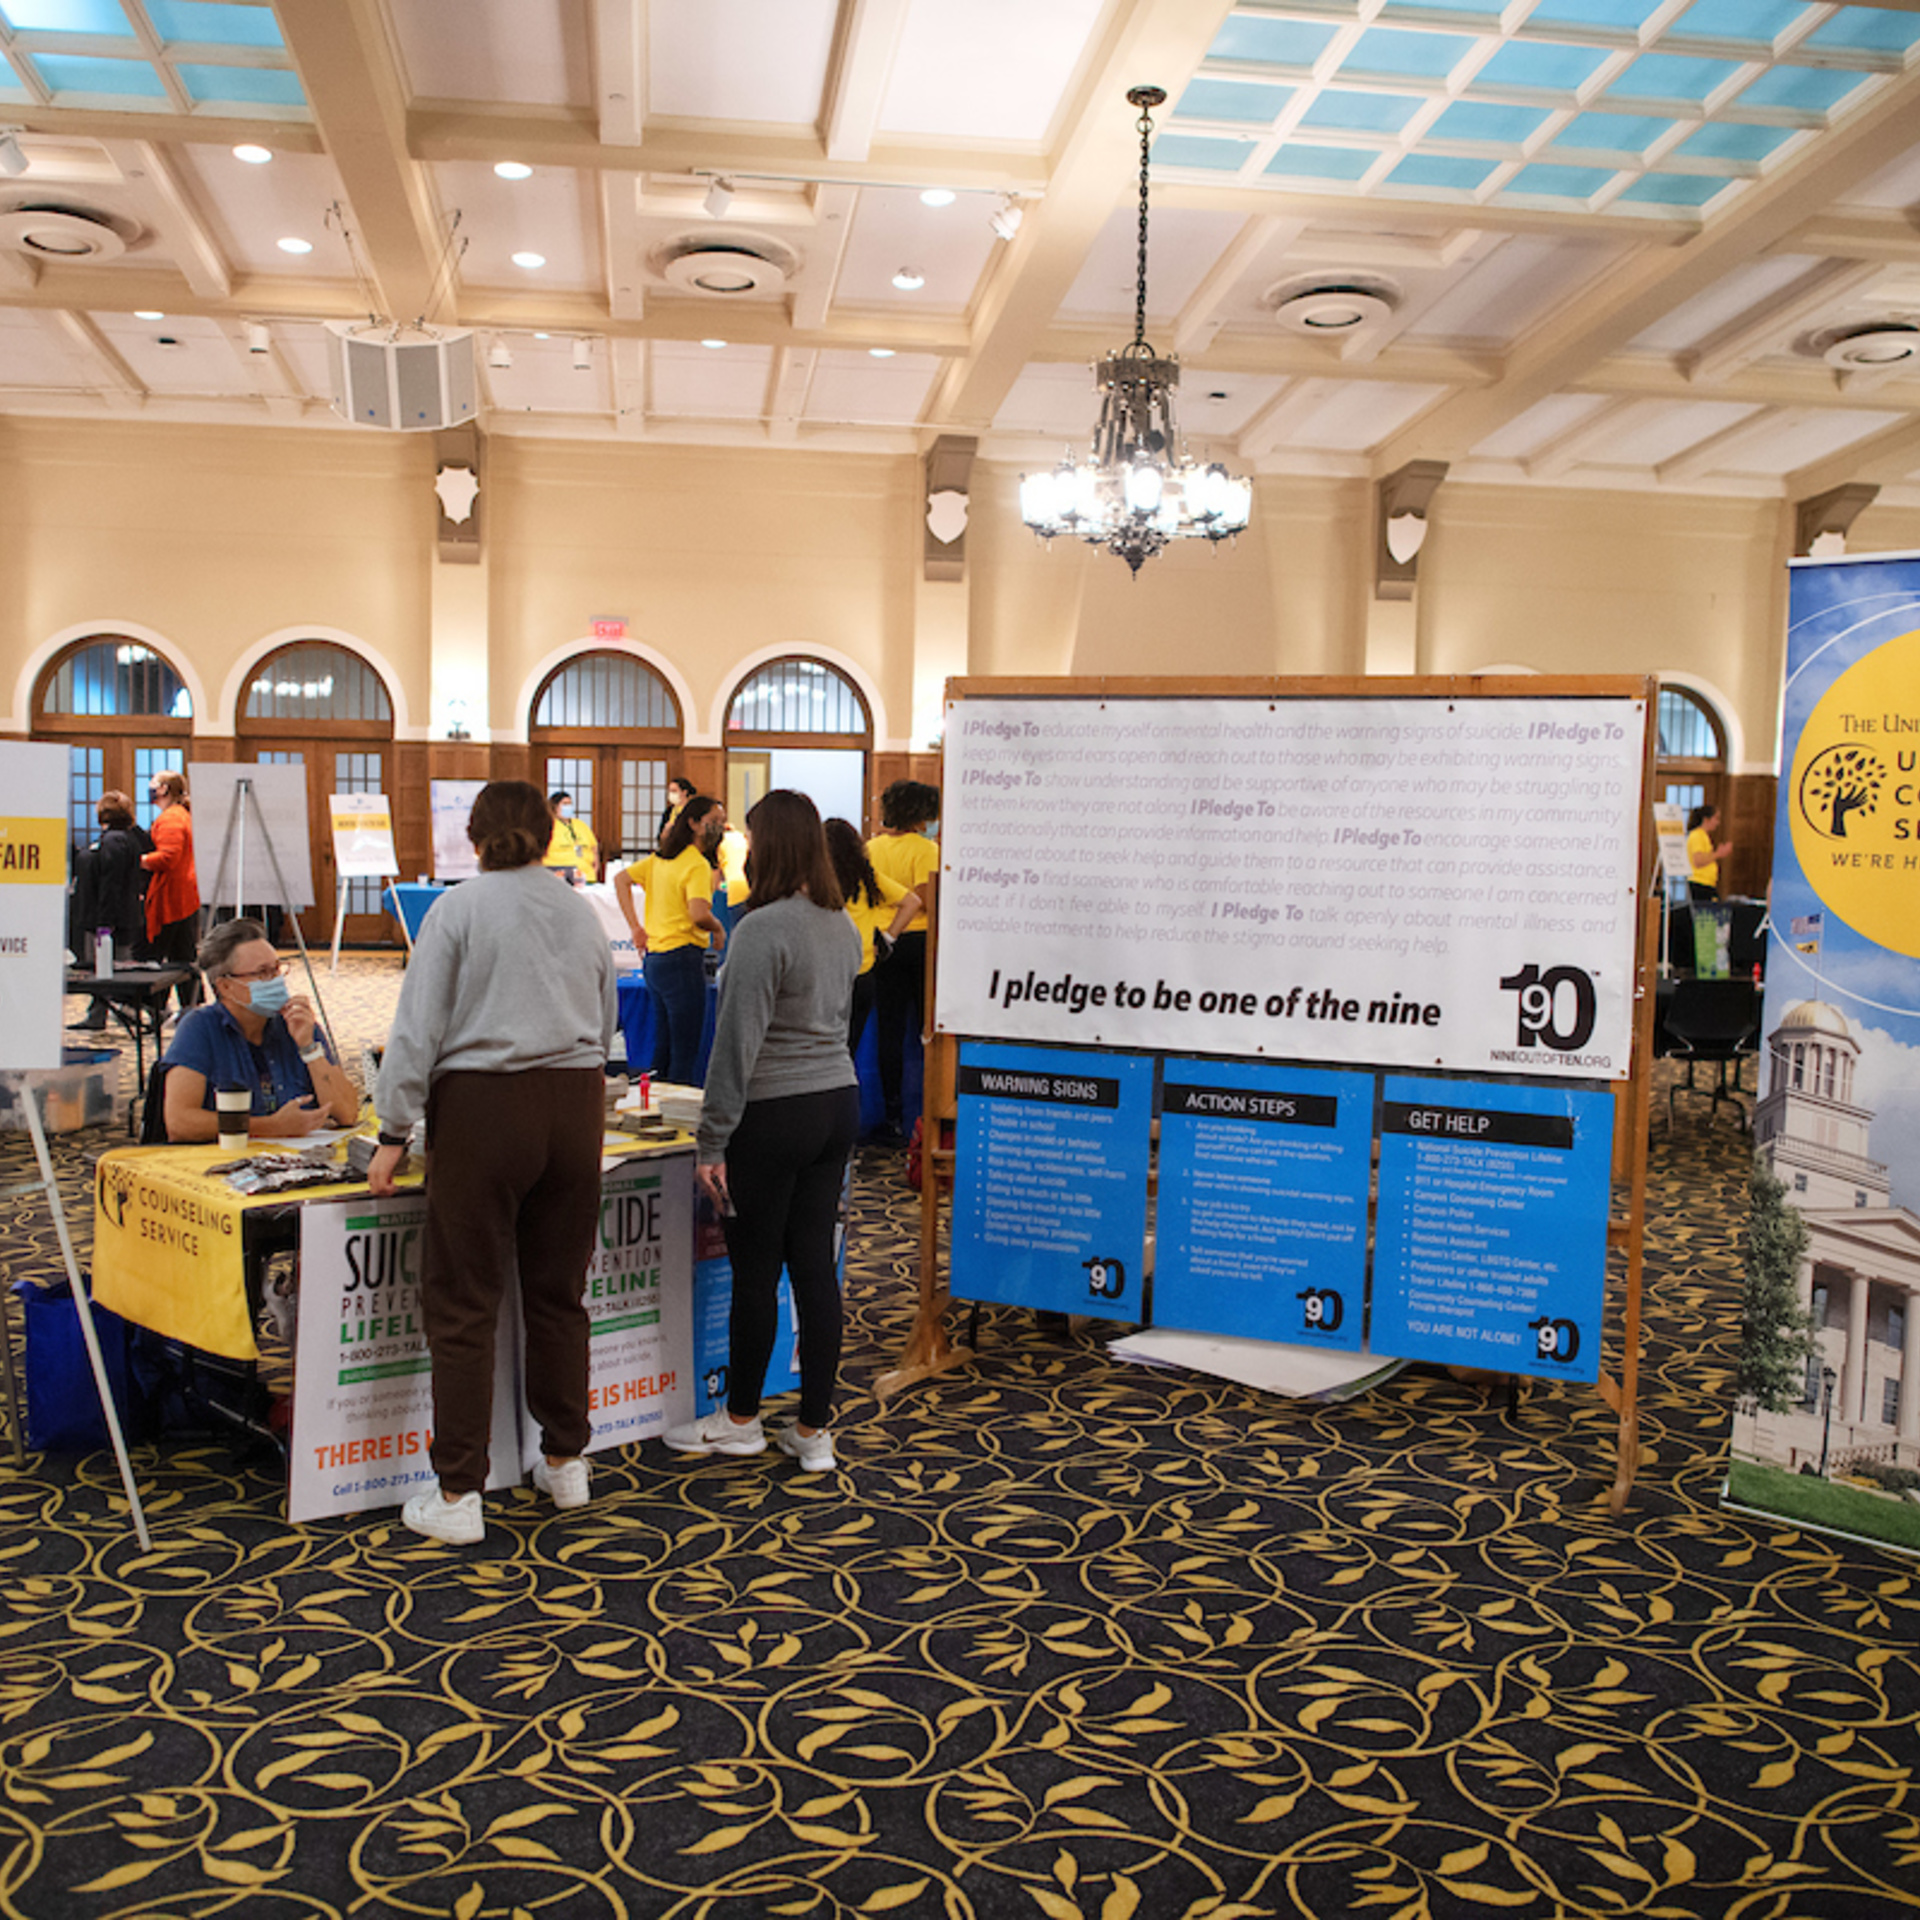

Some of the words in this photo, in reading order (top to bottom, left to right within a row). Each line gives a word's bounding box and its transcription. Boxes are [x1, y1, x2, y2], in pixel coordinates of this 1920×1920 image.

[963, 719, 968, 736] I
[969, 720, 1020, 741] Pledge
[1022, 721, 1039, 737] To
[1528, 723, 1535, 739] I
[1536, 723, 1600, 744] Pledge
[1604, 723, 1623, 739] To
[962, 769, 967, 785] I
[969, 769, 1021, 790] Pledge
[1026, 771, 1042, 786] To
[1191, 799, 1195, 815] I
[1199, 800, 1253, 820] Pledge
[1257, 801, 1275, 817] To
[1334, 828, 1339, 844] I
[1341, 829, 1399, 849] Pledge
[1403, 830, 1421, 846] To
[959, 866, 964, 882] I
[967, 867, 1020, 888] Pledge
[1023, 868, 1040, 884] To
[1211, 902, 1217, 918] I
[1222, 903, 1278, 924] Pledge
[1286, 905, 1304, 921] To
[989, 969, 1001, 999] I
[1003, 971, 1107, 1013] pledge
[1114, 981, 1146, 1009] to
[1154, 980, 1192, 1012] be
[1198, 991, 1257, 1015] one
[1264, 987, 1303, 1017] of
[1306, 990, 1359, 1021] the
[1367, 993, 1441, 1026] nine
[981, 1074, 1050, 1095] WARNING
[1052, 1080, 1098, 1099] SIGNS
[1185, 1092, 1246, 1112] ACTION
[1249, 1098, 1296, 1117] STEPS
[1409, 1111, 1442, 1130] GET
[1445, 1114, 1490, 1133] HELP
[139, 1187, 232, 1235] COUNSELING
[600, 1192, 661, 1249] CIDE
[140, 1218, 198, 1256] SERVICE
[344, 1229, 419, 1292] SUIC
[592, 1268, 661, 1298] ELINE
[341, 1288, 422, 1318] PREVEN
[340, 1314, 419, 1344] LIFEL
[1407, 1320, 1430, 1333] YOU
[1432, 1323, 1453, 1337] ARE
[1456, 1326, 1478, 1340] NOT
[603, 1384, 620, 1408] IS
[624, 1370, 677, 1402] HELP!
[314, 1435, 393, 1470] THERE
[397, 1431, 420, 1456] IS
